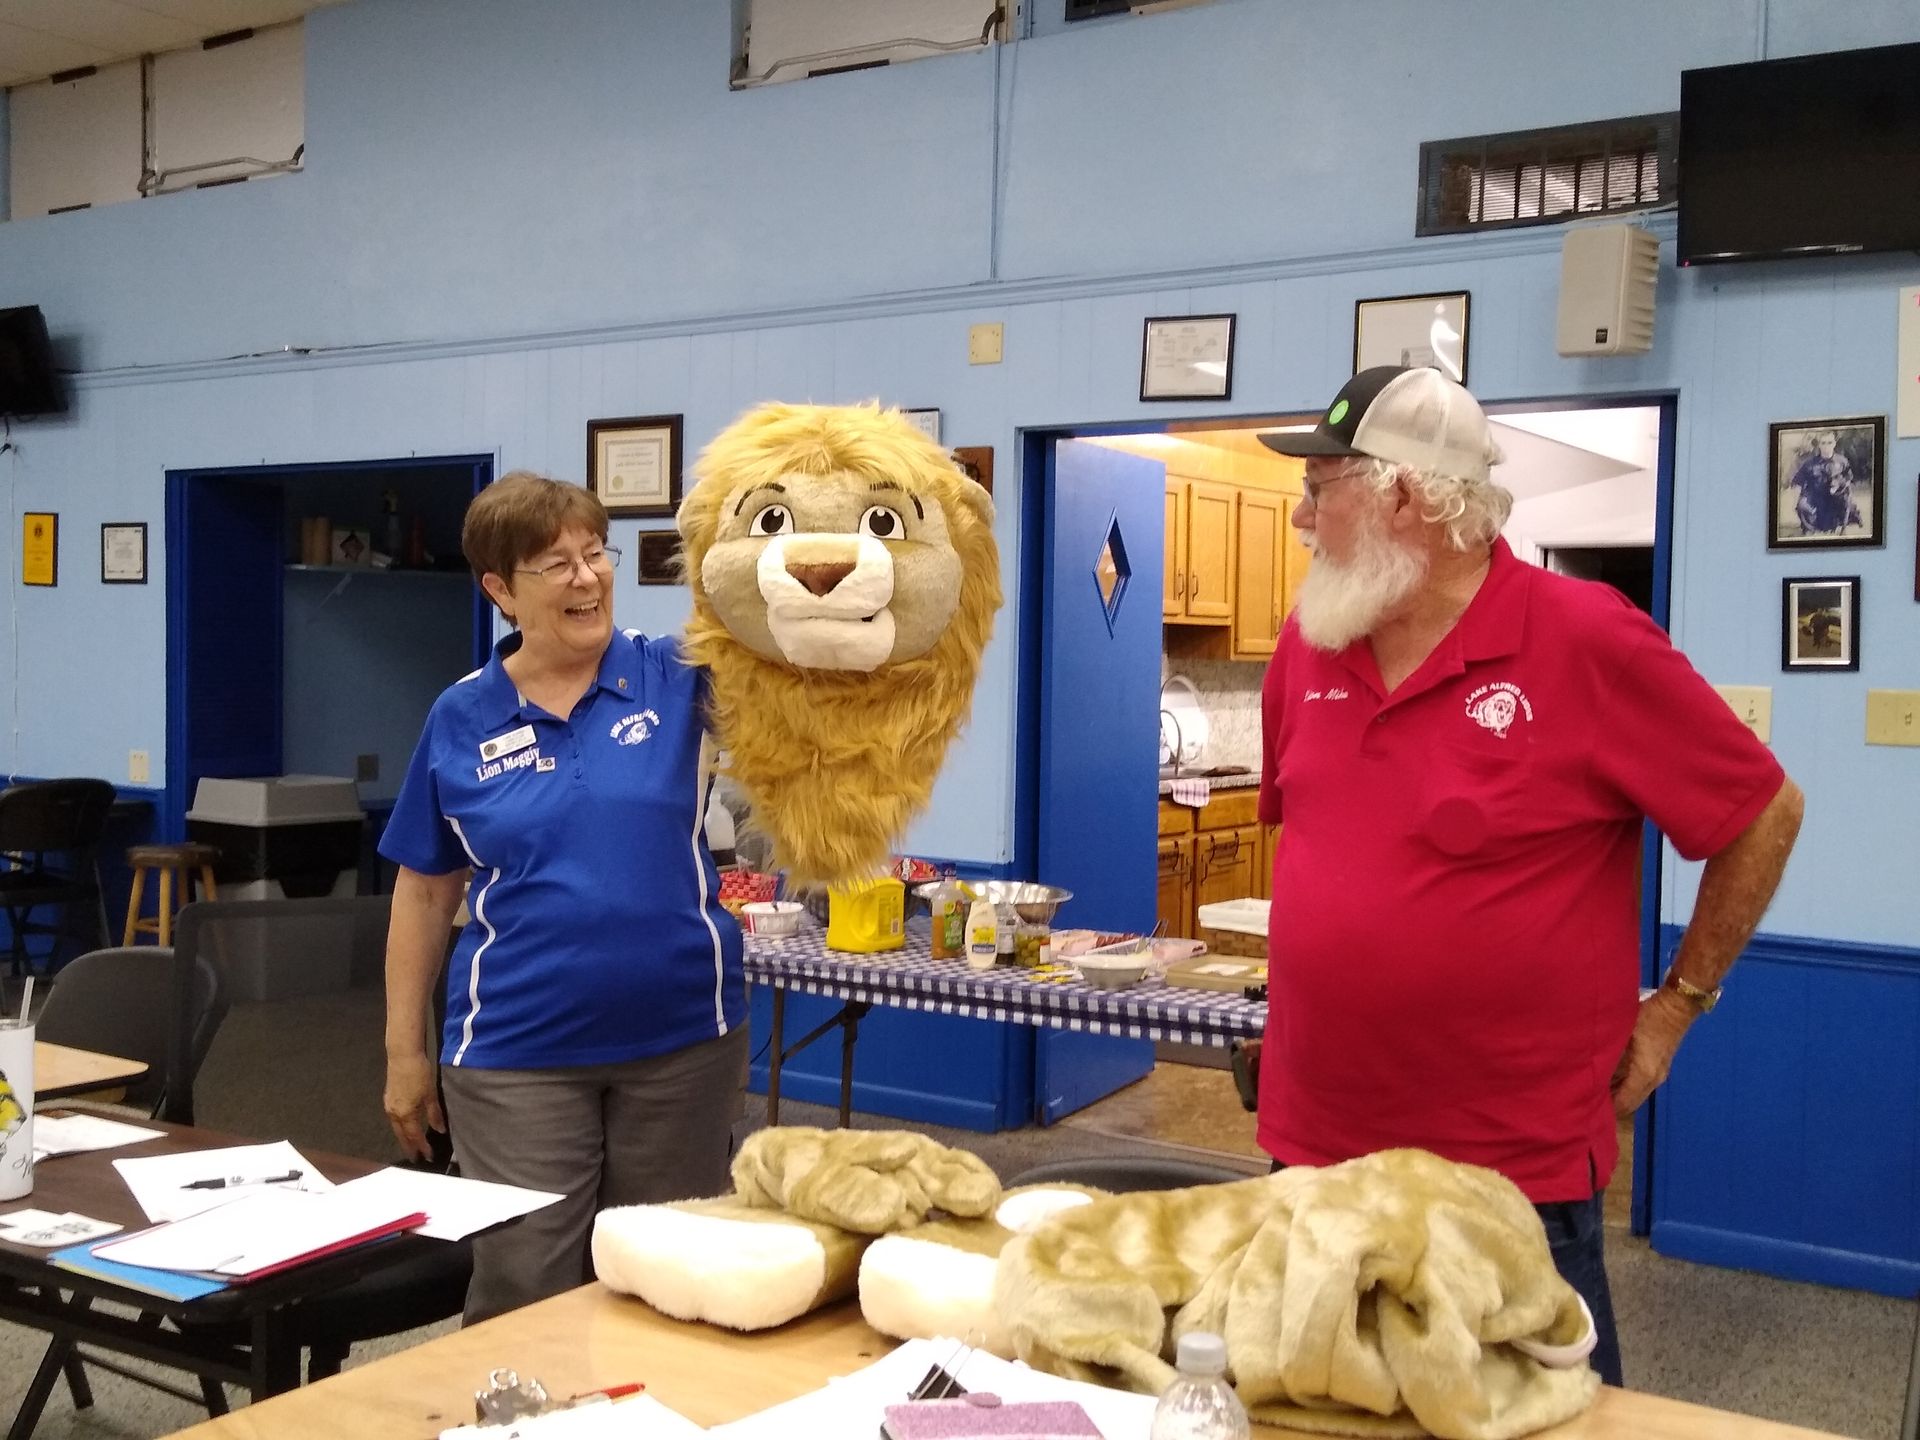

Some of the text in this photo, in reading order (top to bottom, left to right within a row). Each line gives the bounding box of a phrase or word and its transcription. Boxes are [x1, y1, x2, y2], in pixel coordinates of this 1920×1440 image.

[1465, 682, 1533, 722] LAKE ALFRED LIONS
[476, 764, 502, 782] Lion
